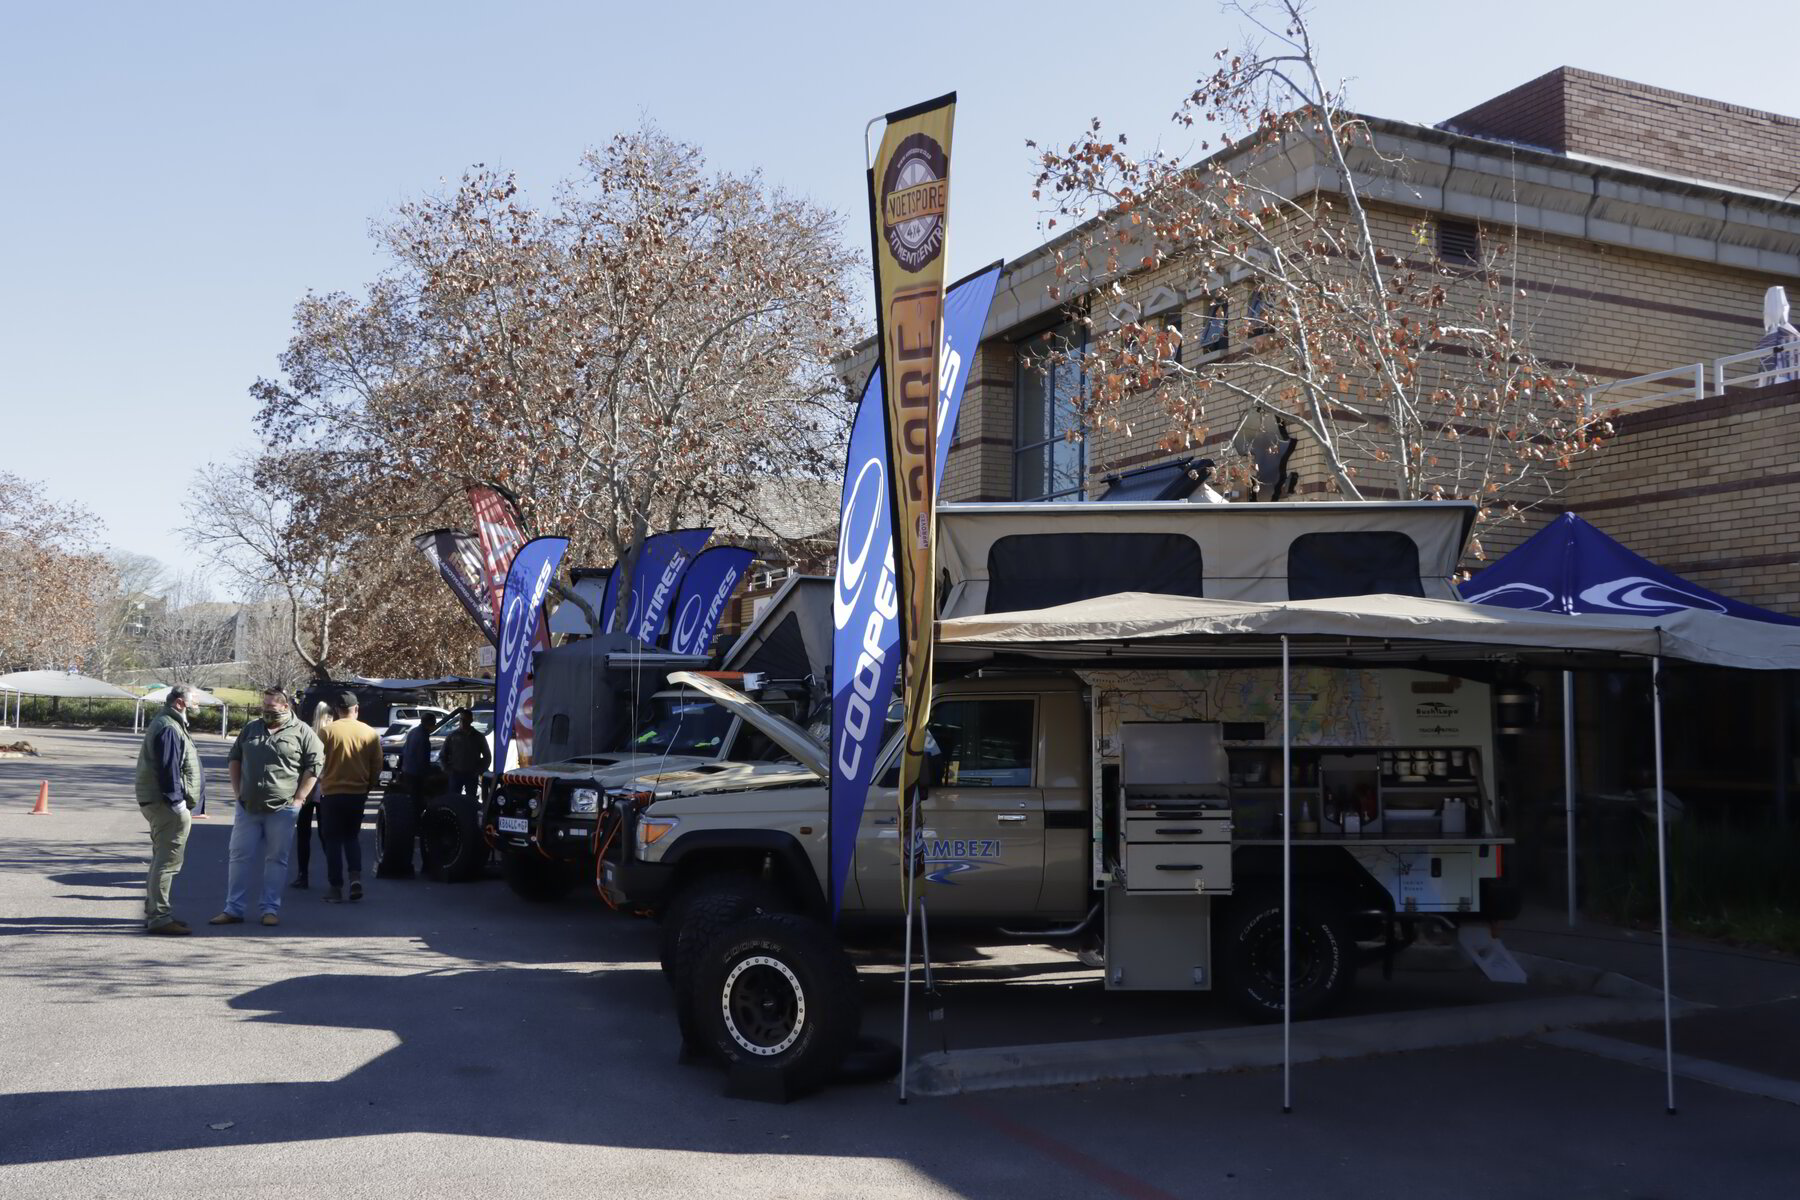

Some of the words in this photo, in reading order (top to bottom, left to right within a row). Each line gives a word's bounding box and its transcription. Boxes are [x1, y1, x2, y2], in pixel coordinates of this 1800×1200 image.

[888, 184, 945, 219] VOETSPORE
[643, 551, 686, 622] TIRES
[703, 566, 737, 630] TIRES
[500, 631, 530, 746] COOPER
[525, 557, 552, 637] TIRES
[922, 839, 1001, 858] AMBEZI
[1239, 907, 1280, 942] COOPER
[722, 940, 785, 964] COOPER
